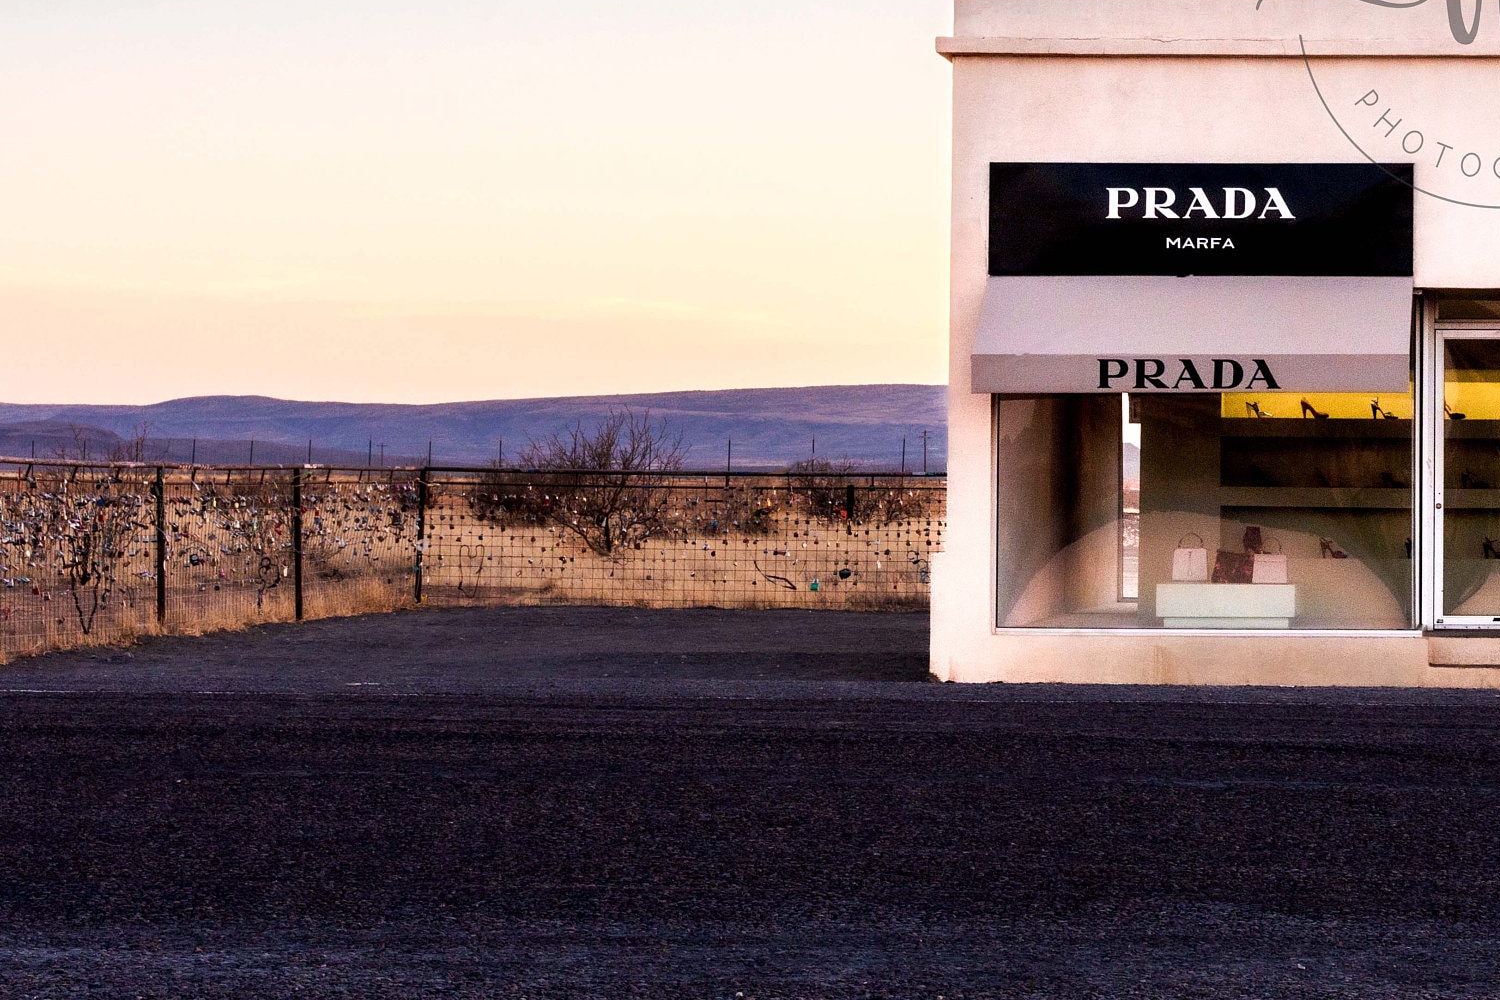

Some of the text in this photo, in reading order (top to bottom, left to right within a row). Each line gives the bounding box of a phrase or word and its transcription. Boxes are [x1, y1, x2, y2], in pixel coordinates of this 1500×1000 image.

[1105, 187, 1295, 219] PRADA
[1165, 237, 1235, 249] MARFA
[1096, 358, 1281, 389] PRADA
